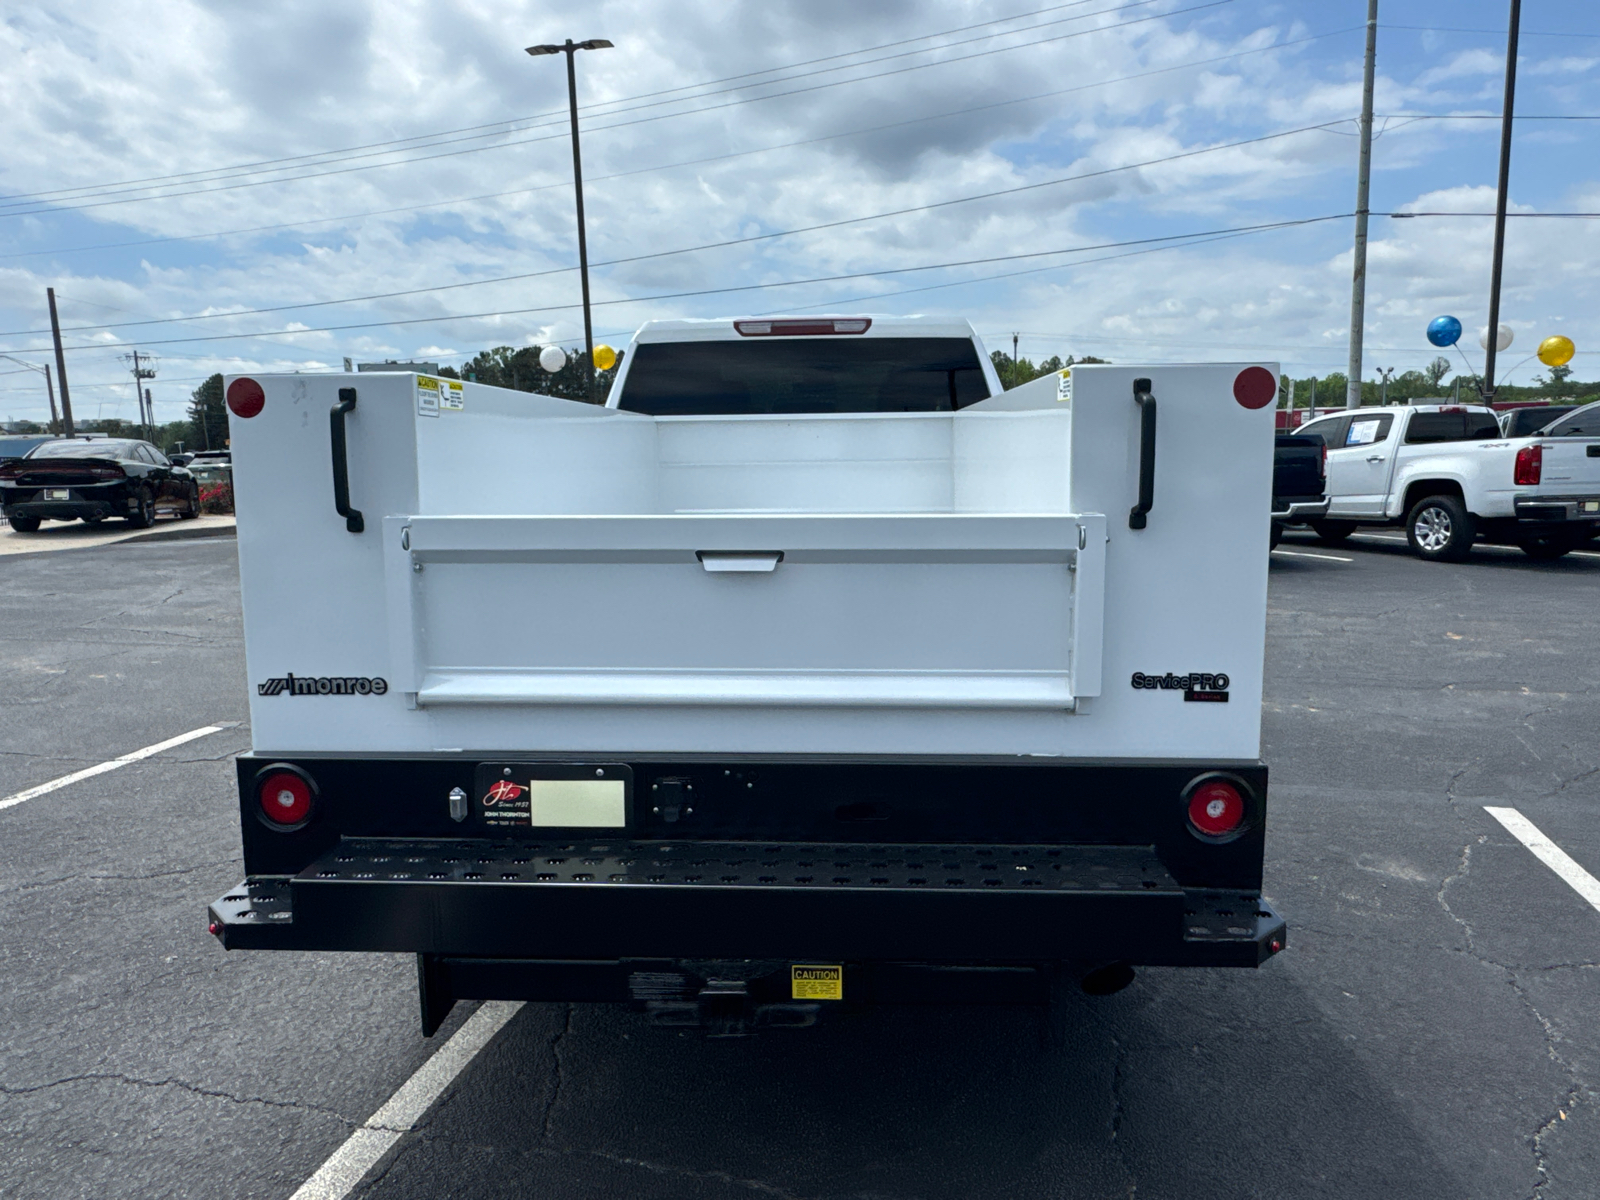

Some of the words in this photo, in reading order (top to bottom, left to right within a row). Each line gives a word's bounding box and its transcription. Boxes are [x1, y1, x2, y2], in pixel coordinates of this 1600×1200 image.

[293, 677, 388, 695] monroe
[1131, 672, 1230, 691] ServicePRO
[795, 970, 838, 980] CAUTION
